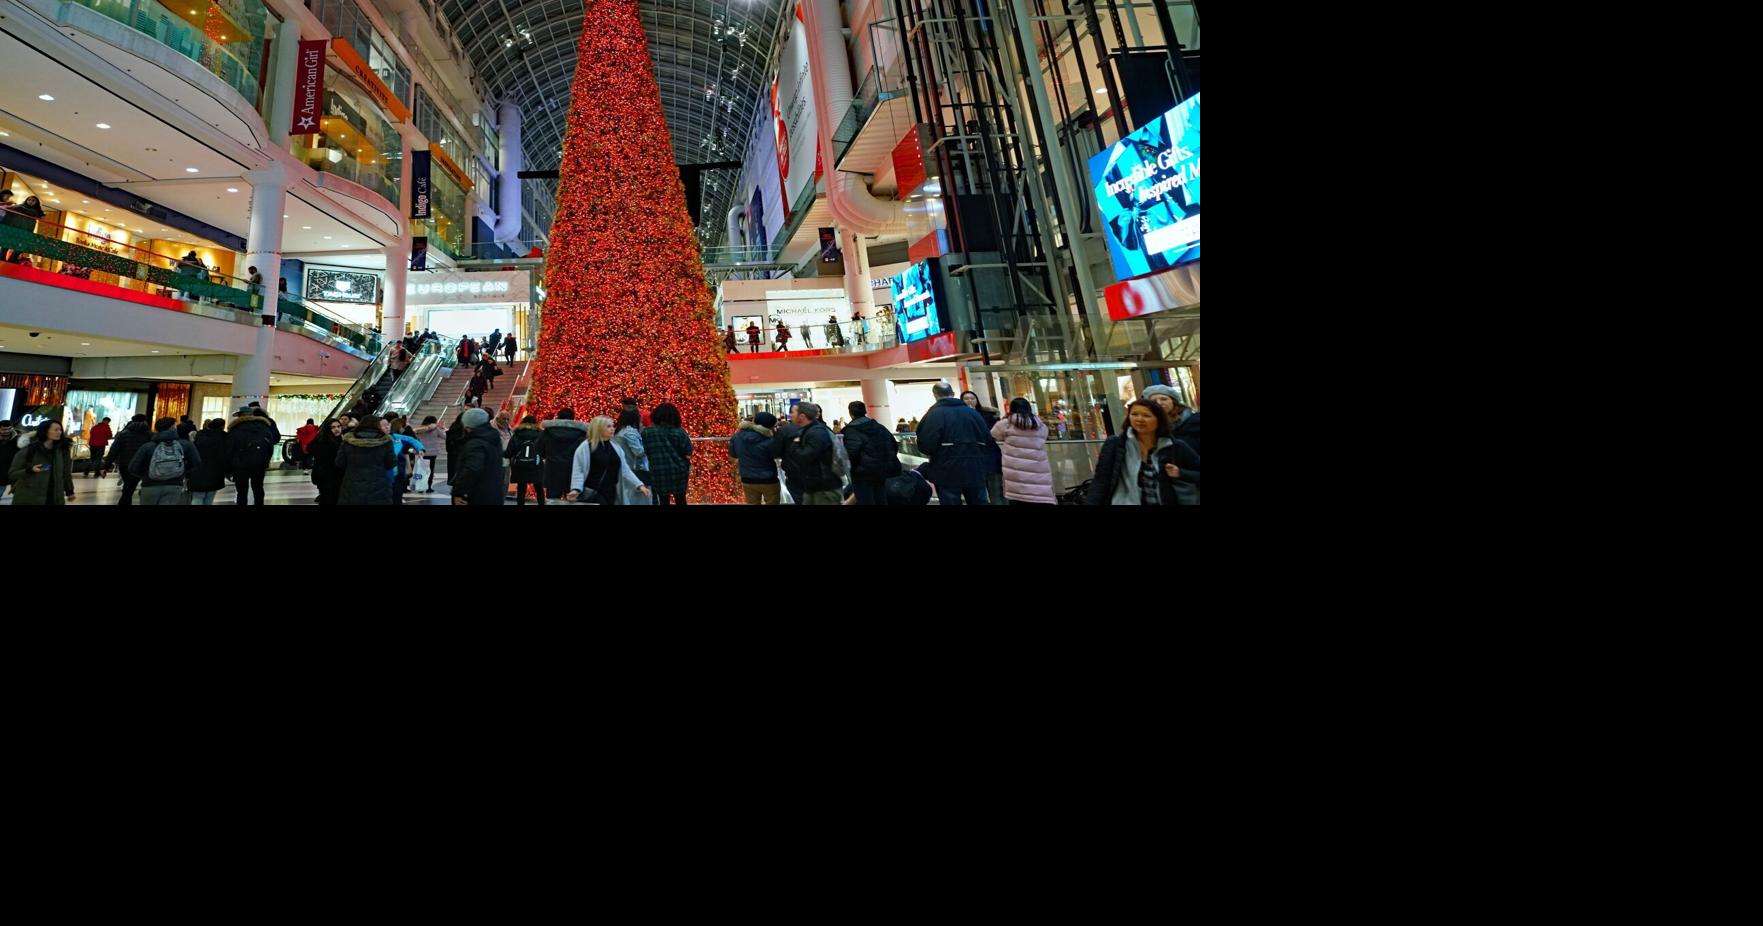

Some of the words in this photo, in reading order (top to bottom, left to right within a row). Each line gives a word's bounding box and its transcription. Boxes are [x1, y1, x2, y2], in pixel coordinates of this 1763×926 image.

[1137, 164, 1188, 204] Inspired
[415, 195, 429, 216] Indigo
[406, 281, 508, 295] EUROPEAN
